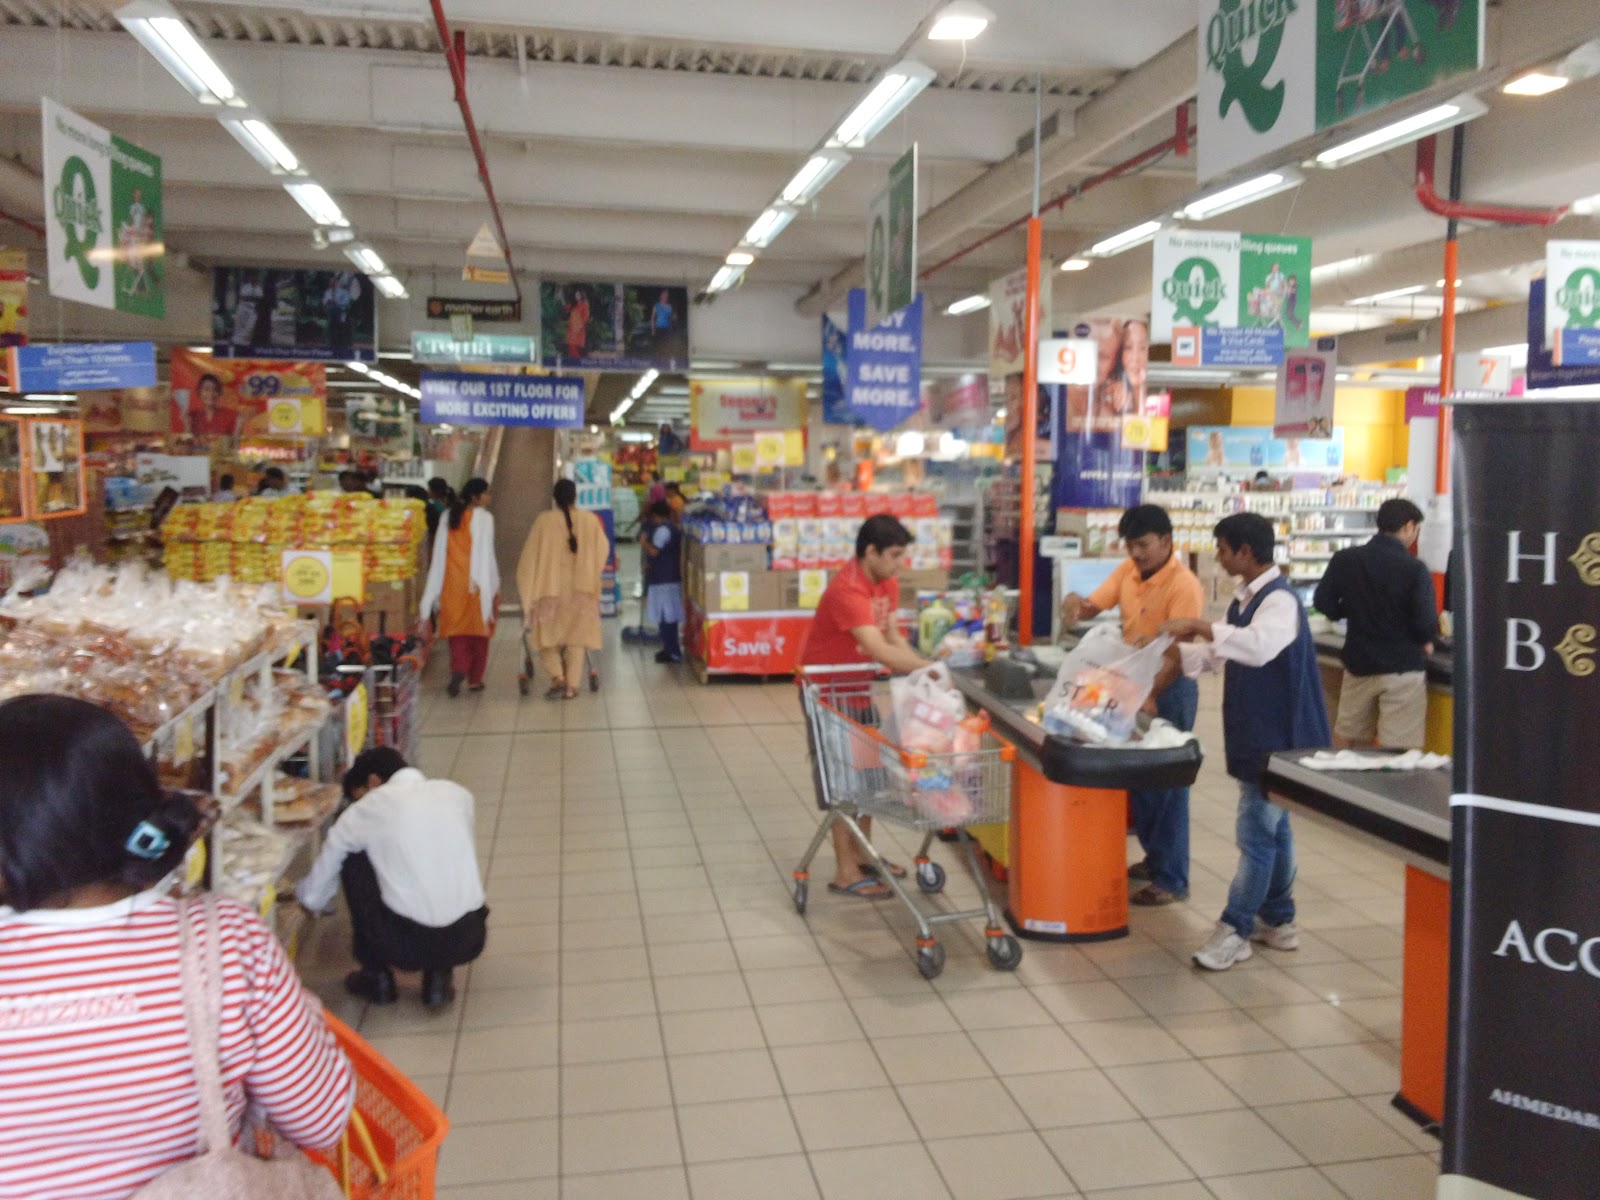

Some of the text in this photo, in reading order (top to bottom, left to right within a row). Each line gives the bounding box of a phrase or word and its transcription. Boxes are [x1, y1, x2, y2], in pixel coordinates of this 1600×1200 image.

[1184, 240, 1209, 248] more
[1211, 239, 1232, 251] long
[1265, 243, 1298, 255] queues
[1162, 276, 1227, 302] Quick
[1057, 346, 1077, 375] 9
[858, 364, 910, 383] SAVE
[1478, 358, 1496, 385] 7
[425, 380, 579, 398] VISIT OUR 1ST FLOOR FOR
[435, 402, 577, 420] MORE EXCITING OFFERS
[723, 637, 771, 657] Save
